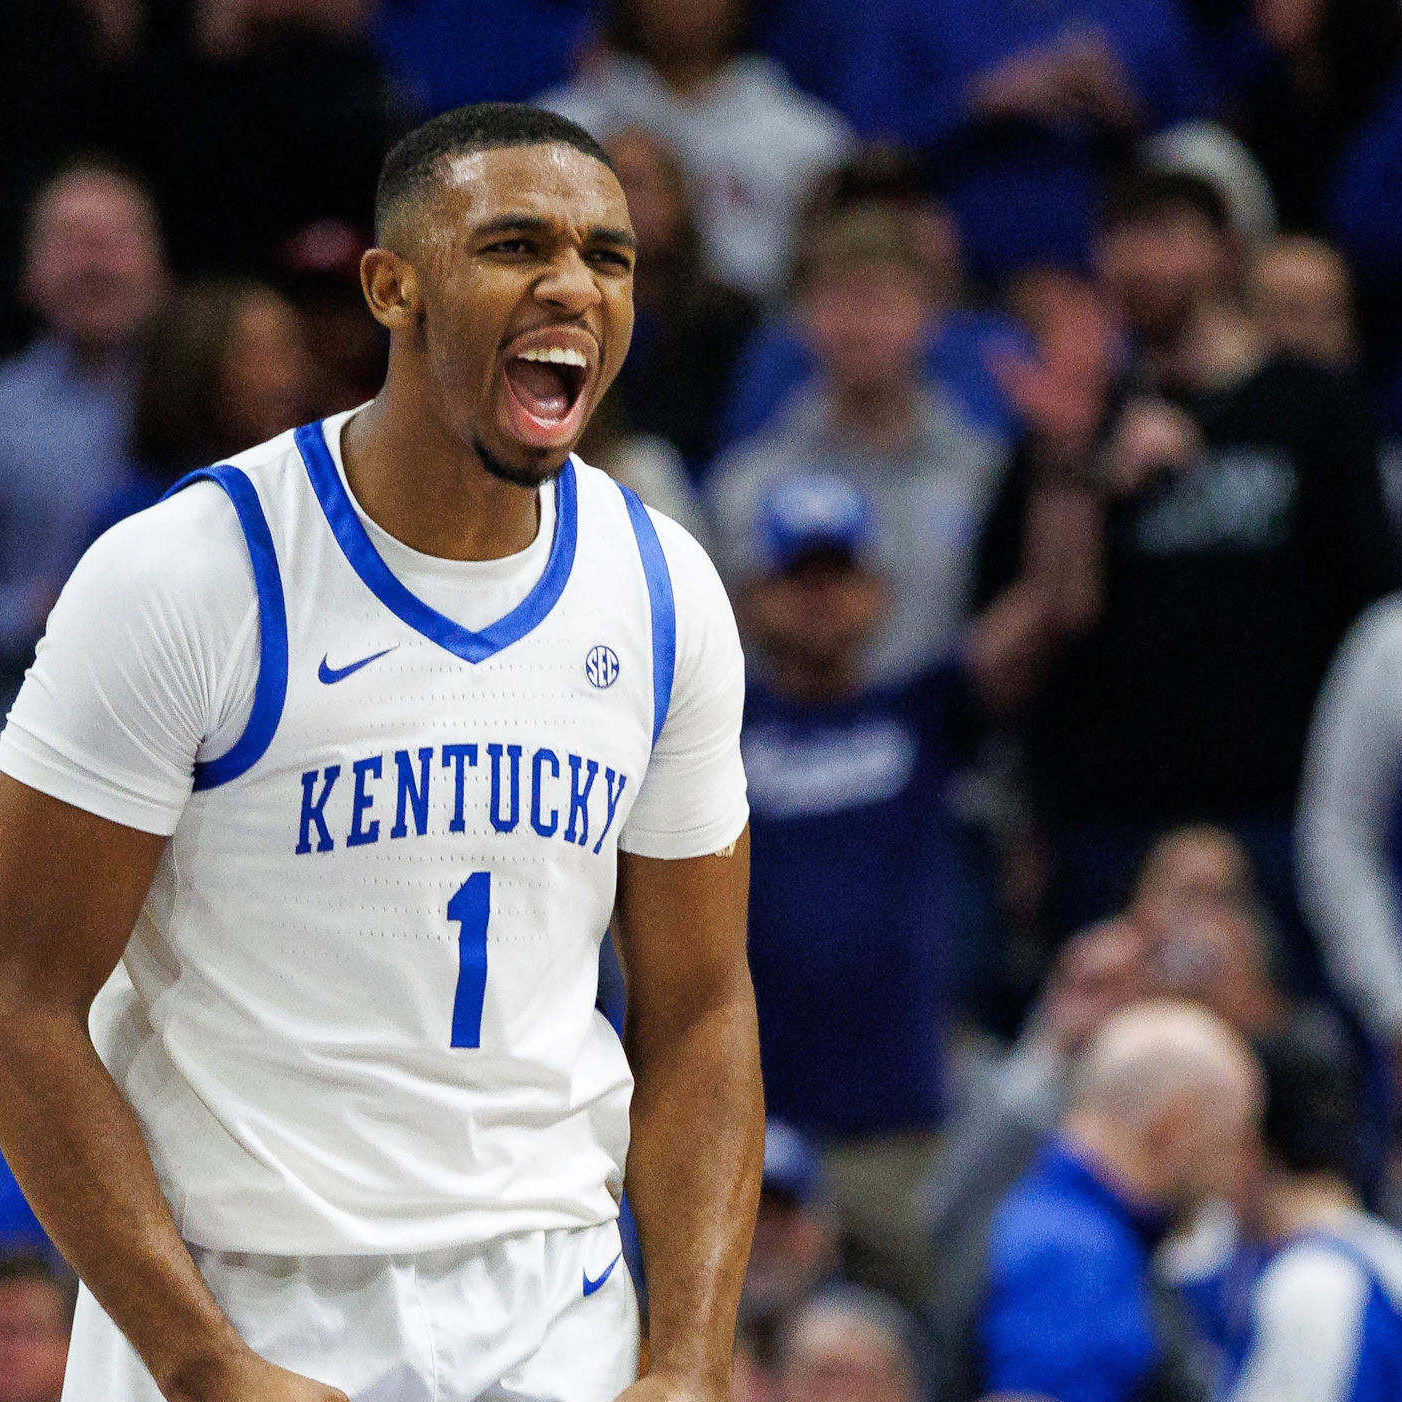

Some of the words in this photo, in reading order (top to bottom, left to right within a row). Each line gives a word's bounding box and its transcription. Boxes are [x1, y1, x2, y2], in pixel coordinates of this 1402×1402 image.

[586, 645, 619, 688] SEC
[296, 744, 626, 855] KENTUCKY
[447, 873, 491, 1049] 1
